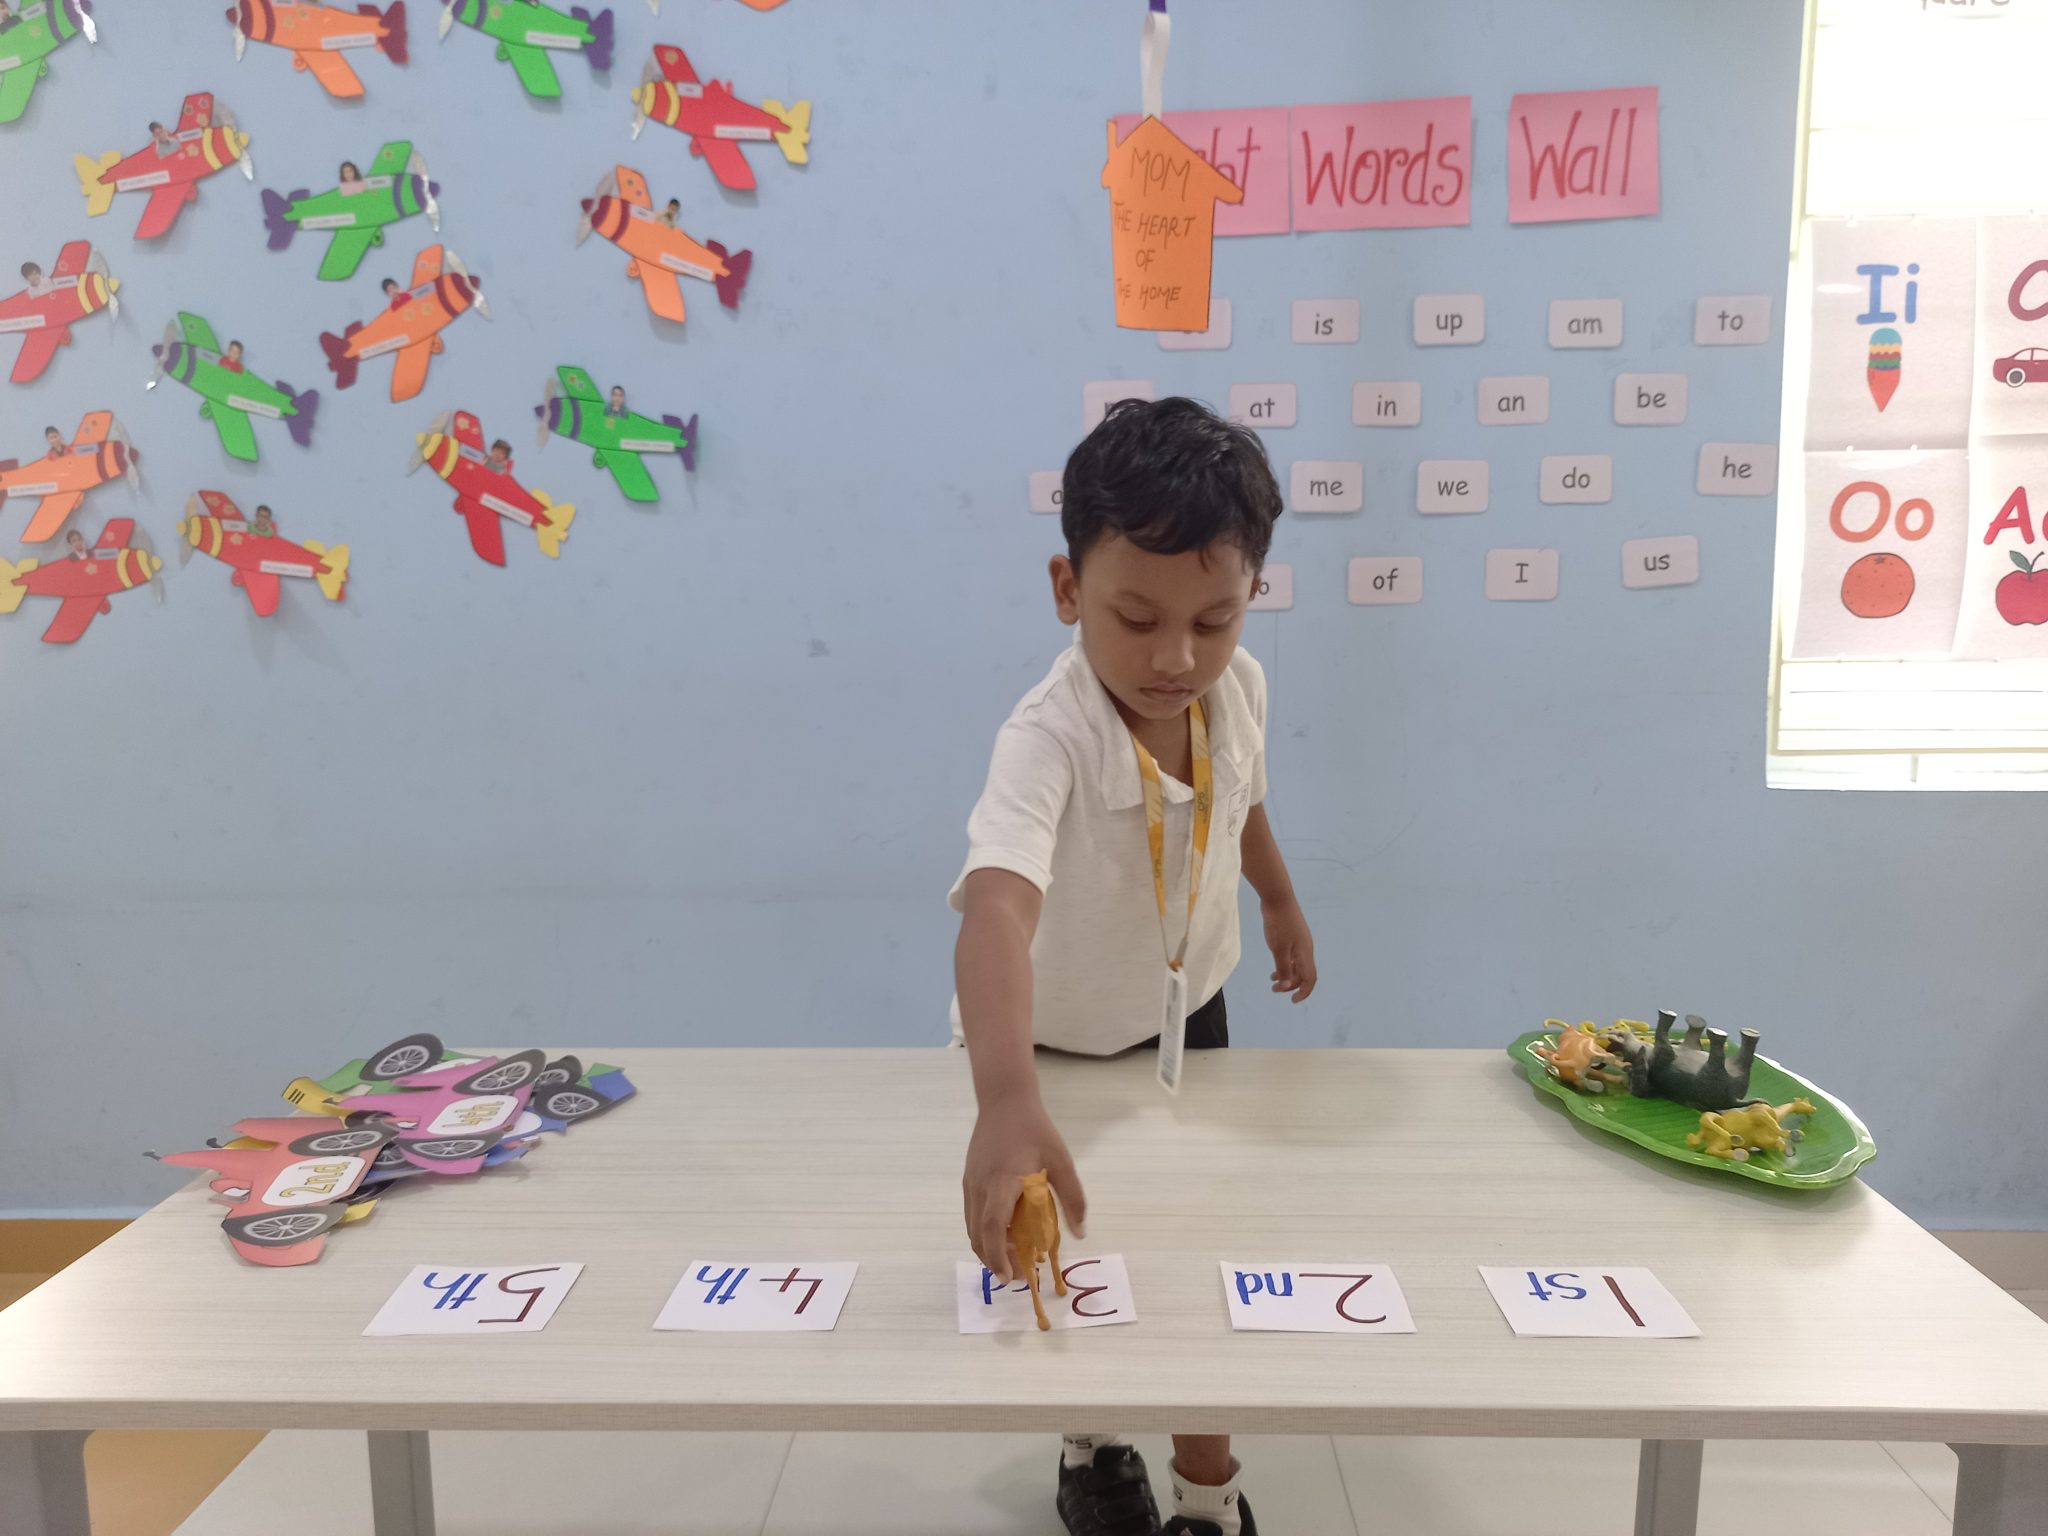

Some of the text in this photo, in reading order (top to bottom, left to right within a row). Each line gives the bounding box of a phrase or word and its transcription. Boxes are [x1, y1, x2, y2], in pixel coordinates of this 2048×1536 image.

[1302, 122, 1464, 207] Words
[1519, 107, 1637, 200] Wall
[1130, 147, 1191, 202] MOM
[1137, 212, 1197, 250] HEART
[1135, 249, 1156, 272] OF
[1139, 284, 1182, 310] HOME
[1856, 263, 1920, 325] Ii
[1314, 313, 1334, 335] is
[1435, 313, 1463, 337] up
[1568, 317, 1603, 334] am
[1717, 310, 1744, 331] to
[1250, 398, 1275, 418] at
[1376, 394, 1397, 416] in
[1497, 395, 1525, 412] an
[1637, 386, 1667, 408] be
[1562, 466, 1591, 489] do
[1722, 456, 1752, 479] he
[1309, 479, 1344, 496] me
[1437, 479, 1469, 496] we
[1829, 481, 1934, 543] Oo
[1983, 486, 2048, 545] A
[1515, 563, 1529, 583] I
[1643, 554, 1670, 571] us
[1372, 568, 1399, 591] of
[279, 1162, 351, 1197] 2nd
